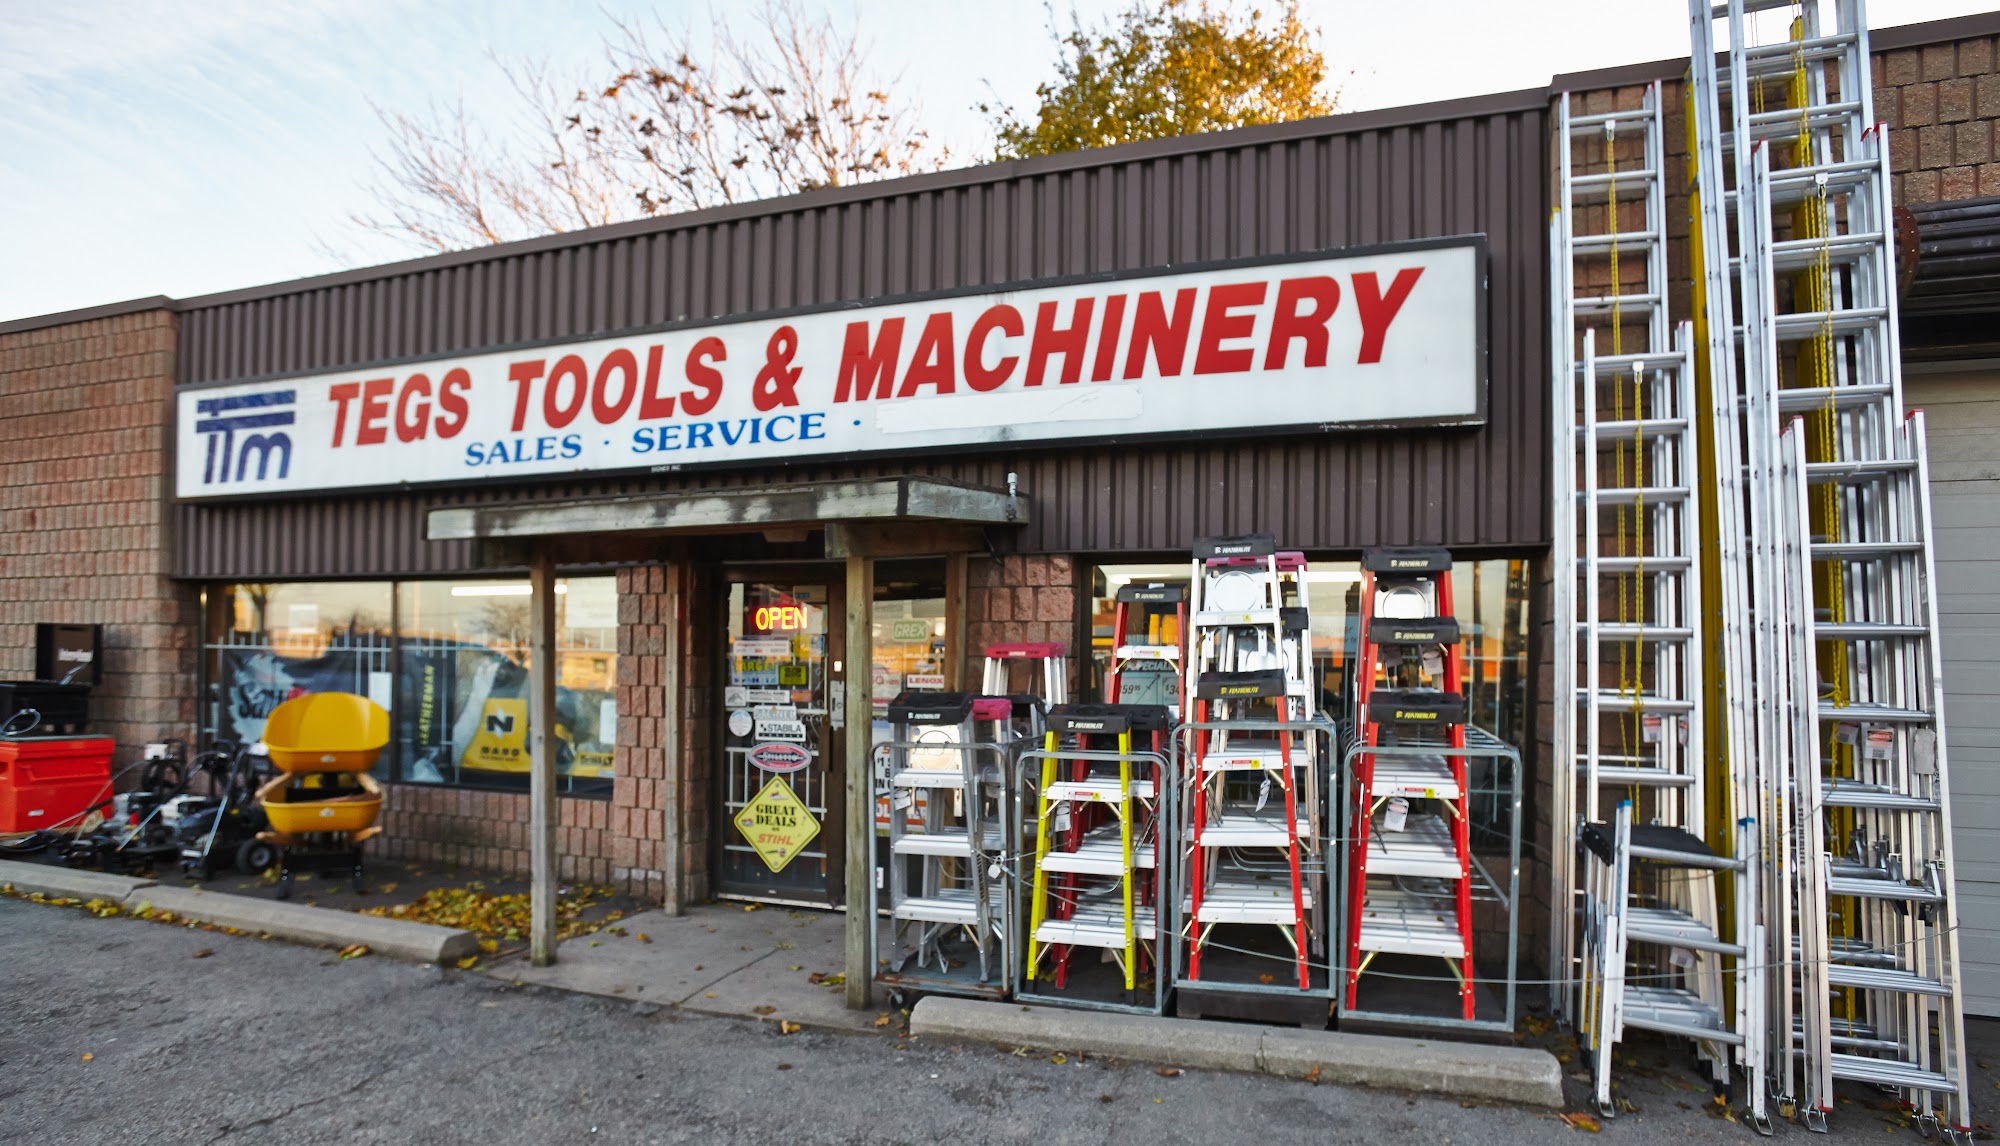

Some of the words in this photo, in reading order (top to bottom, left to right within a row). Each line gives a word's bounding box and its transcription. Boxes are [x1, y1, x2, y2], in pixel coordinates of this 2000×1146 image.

[329, 367, 472, 449] TEGS
[508, 336, 727, 433] TOOLS
[752, 325, 803, 412] &
[833, 266, 1426, 403] MACHINERY
[464, 434, 582, 467] SALES
[631, 412, 826, 453] SERVICE
[755, 606, 808, 631] OPEN
[894, 622, 927, 638] GREX
[767, 723, 801, 733] STABILA
[755, 803, 797, 816] GREAT
[756, 814, 797, 827] DEALS
[758, 833, 794, 846] STIHL
